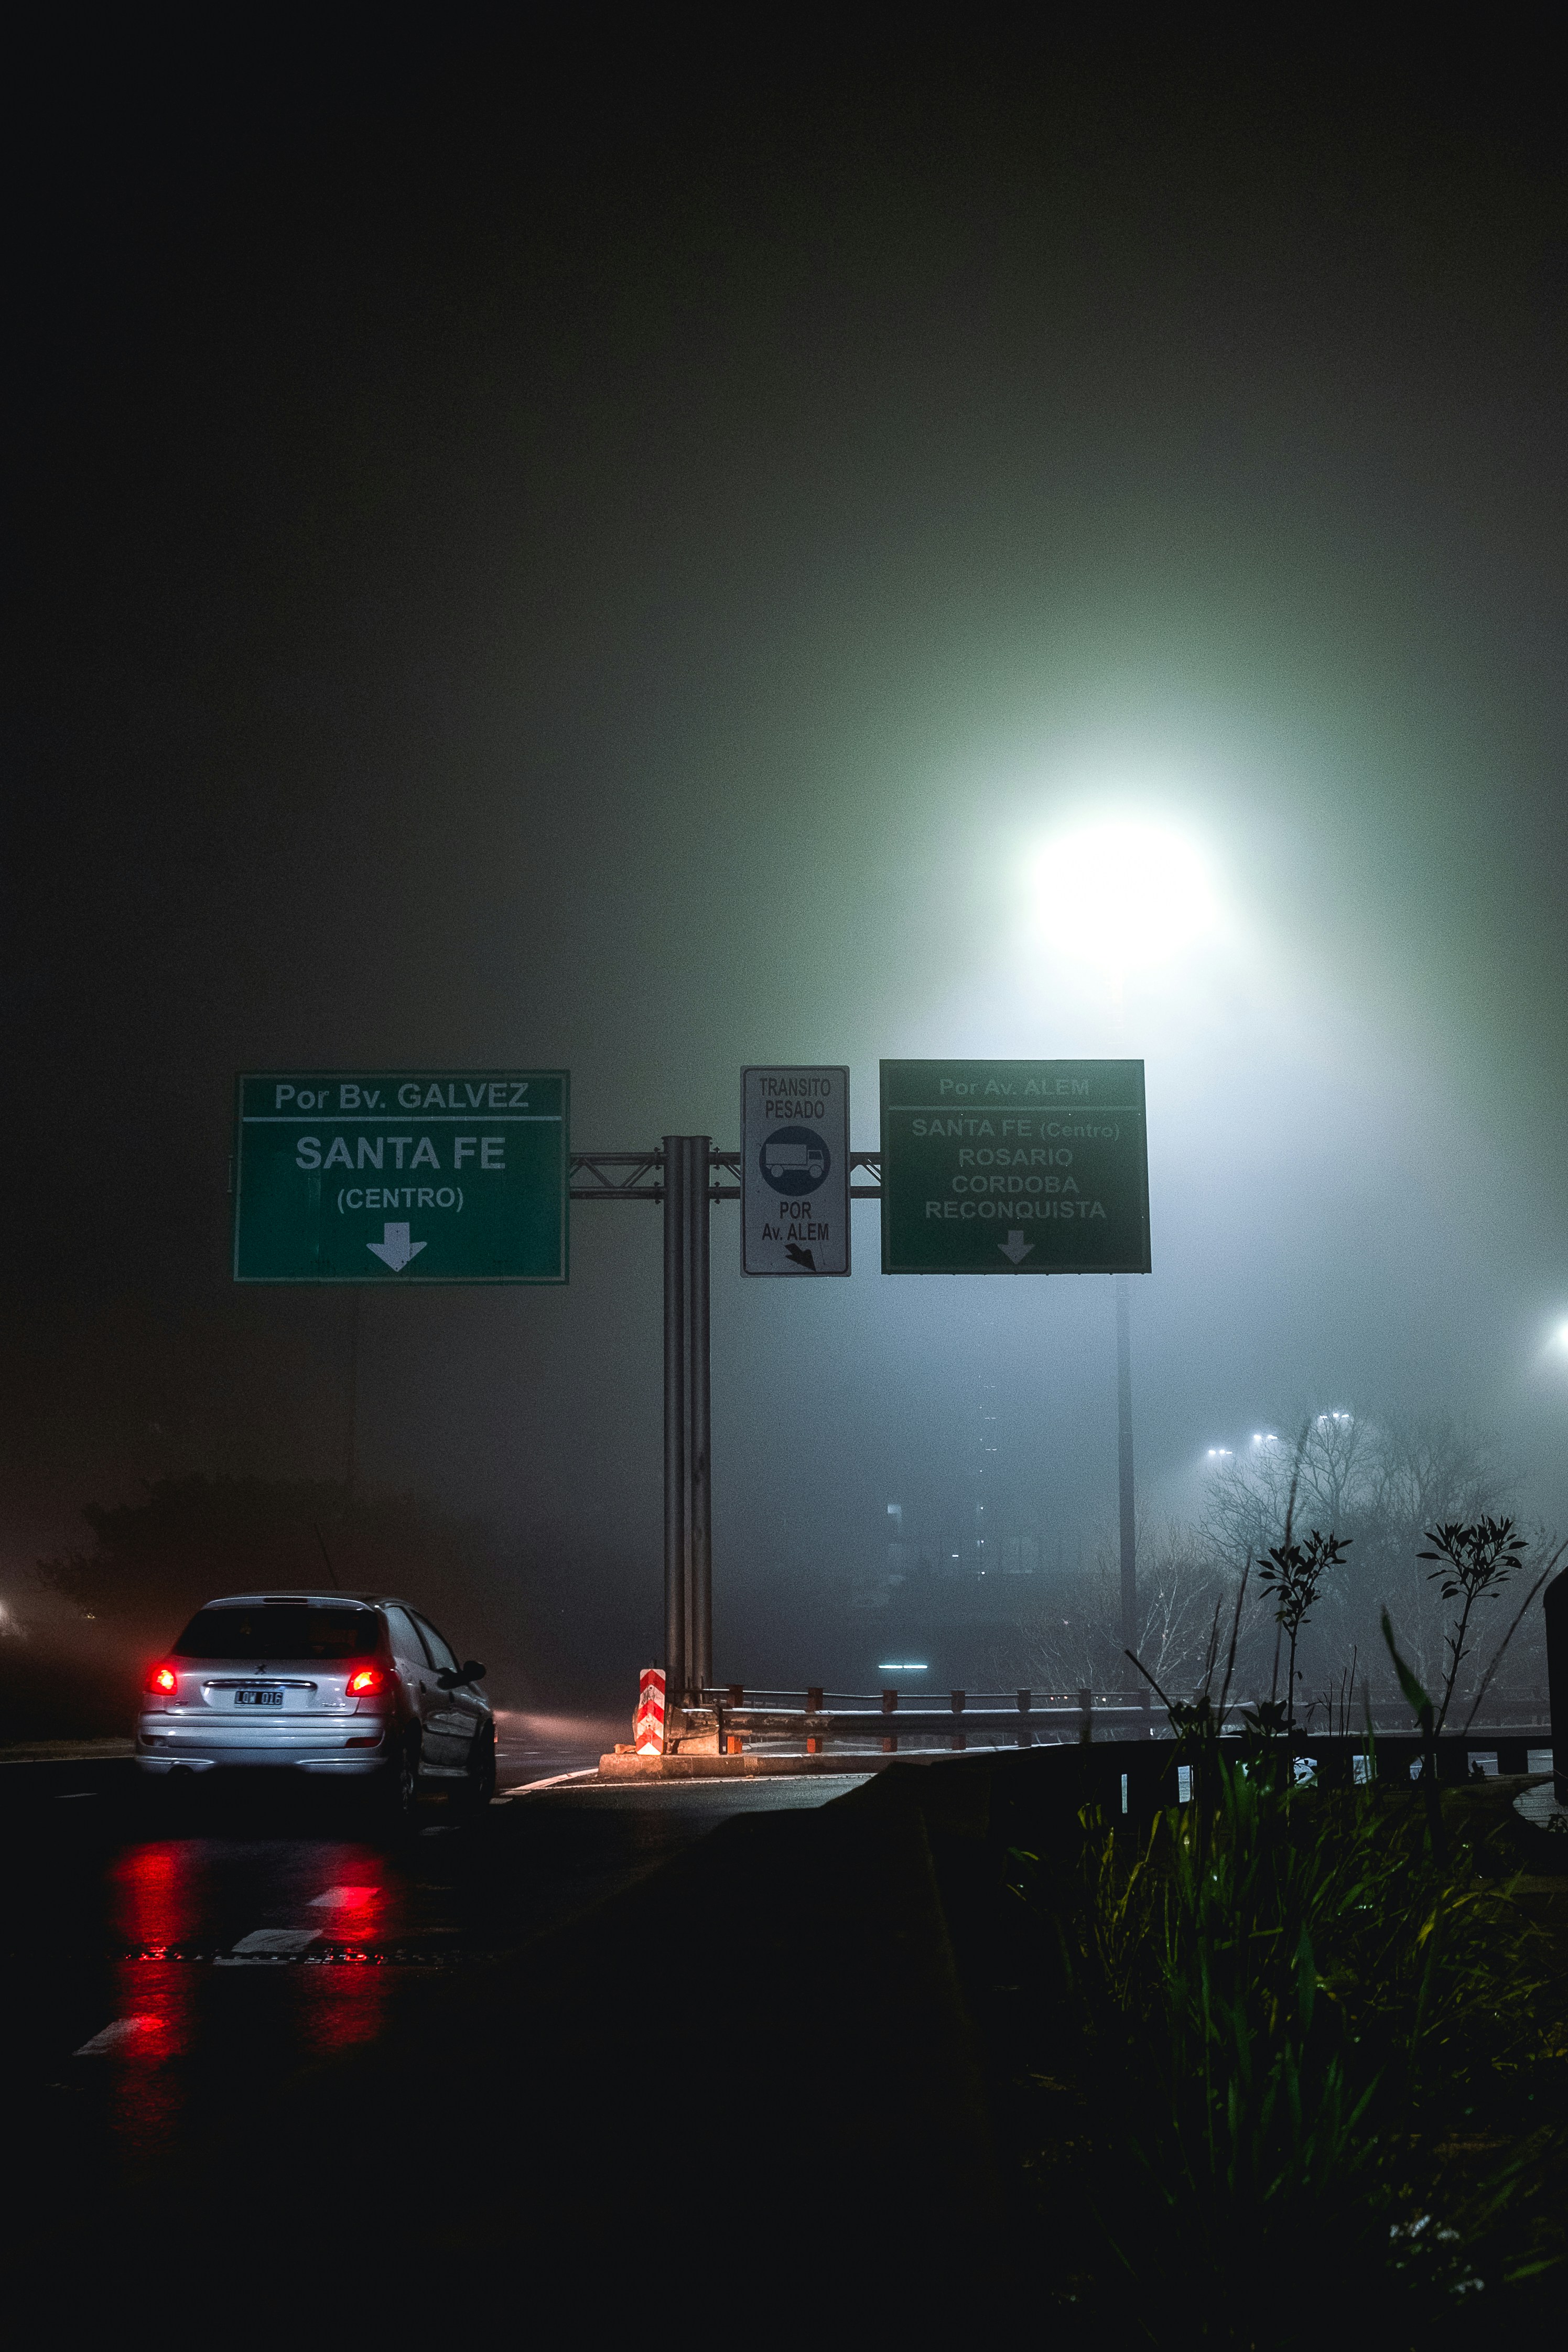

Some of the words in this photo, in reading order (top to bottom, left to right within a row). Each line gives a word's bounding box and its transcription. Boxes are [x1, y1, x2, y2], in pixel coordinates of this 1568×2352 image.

[760, 1078, 830, 1096] TRANSITO
[940, 1080, 978, 1095] Por
[985, 1080, 1016, 1095] Av.
[1025, 1079, 1089, 1095] ALEM
[275, 1084, 329, 1109] Por
[340, 1084, 386, 1108] Bv.
[398, 1083, 528, 1108] GALVEZ
[766, 1101, 825, 1118] PESADO
[912, 1119, 995, 1136] SANTA
[1003, 1120, 1032, 1136] FE
[1040, 1123, 1120, 1141] (Centro)
[296, 1136, 440, 1169] SANTA
[455, 1137, 505, 1169] FE
[959, 1149, 1073, 1166] ROSARIO
[952, 1176, 1079, 1193] CORDOBA
[338, 1188, 463, 1214] (CENTRO)
[780, 1202, 812, 1220] POR
[926, 1202, 1107, 1218] RECONQUISTA
[762, 1223, 783, 1240] Av.
[787, 1223, 829, 1240] ALEM
